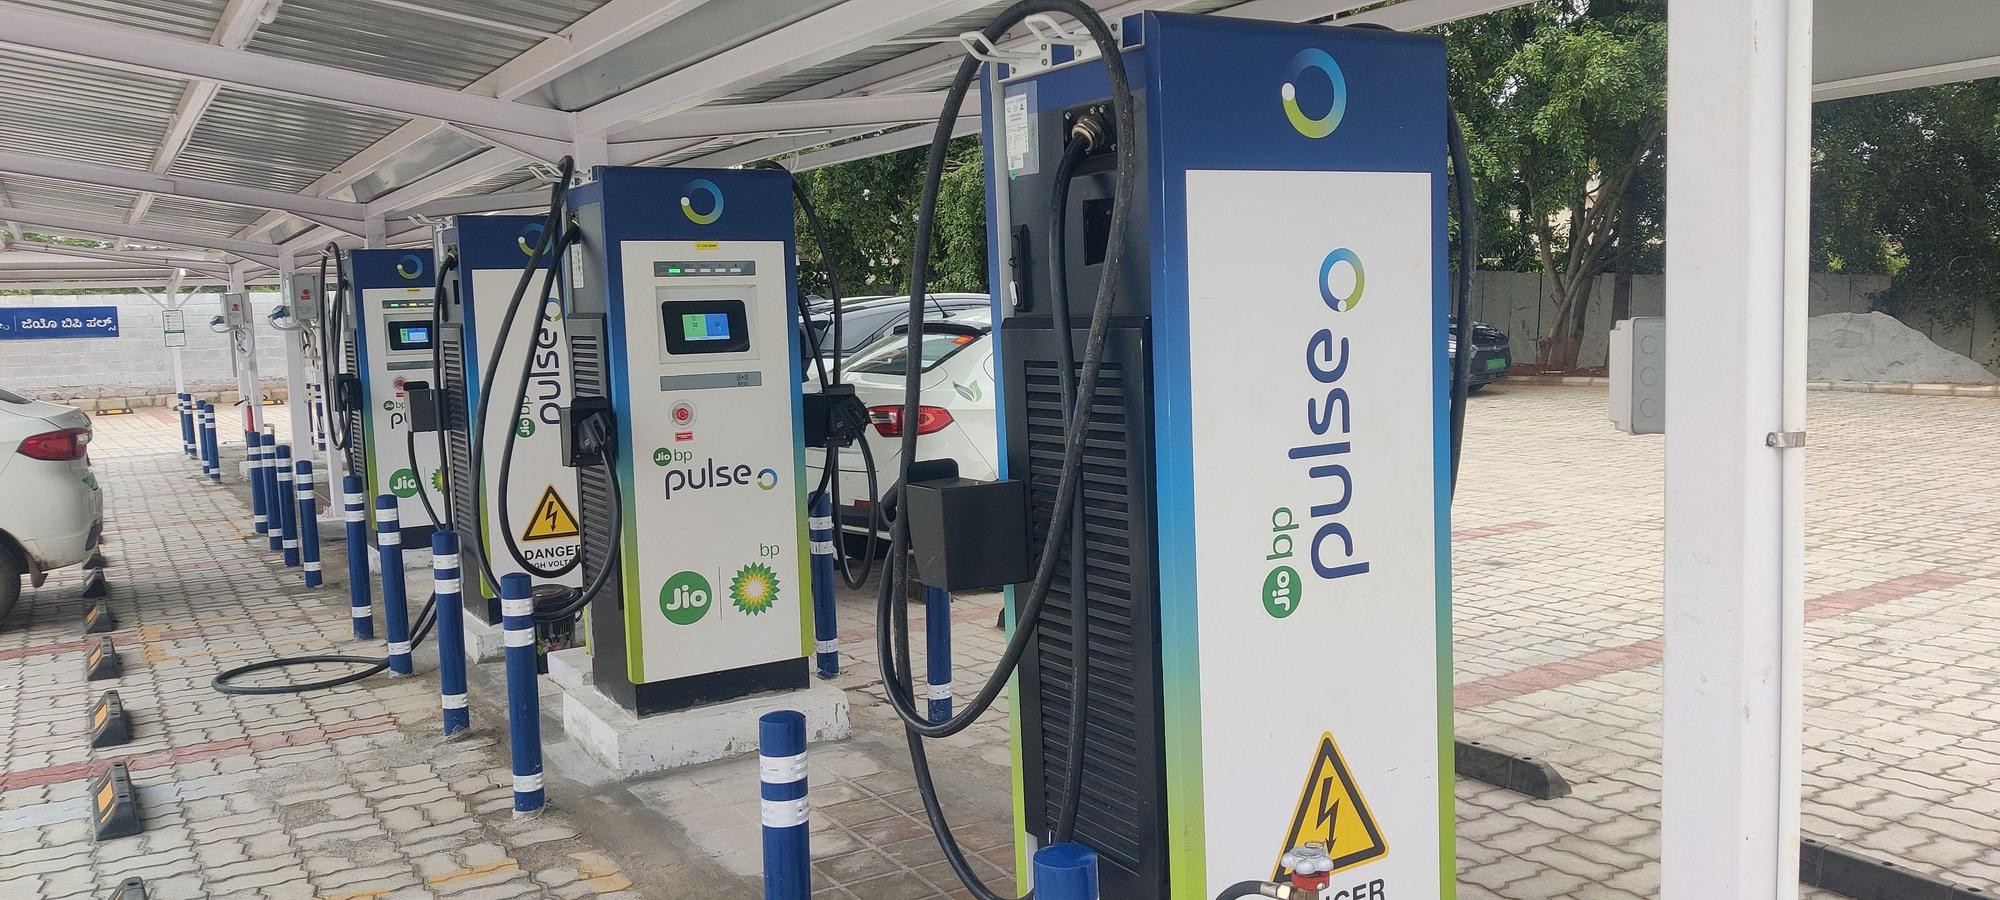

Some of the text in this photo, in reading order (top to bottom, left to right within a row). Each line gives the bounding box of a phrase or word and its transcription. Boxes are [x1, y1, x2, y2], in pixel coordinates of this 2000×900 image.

[520, 419, 530, 436] Jio
[674, 449, 693, 463] bp
[1288, 328, 1369, 580] pulse
[393, 476, 417, 490] Jio
[665, 458, 752, 500] pulse
[759, 543, 780, 559] bp
[1266, 506, 1299, 611] Jio bp
[666, 584, 708, 611] Jio
